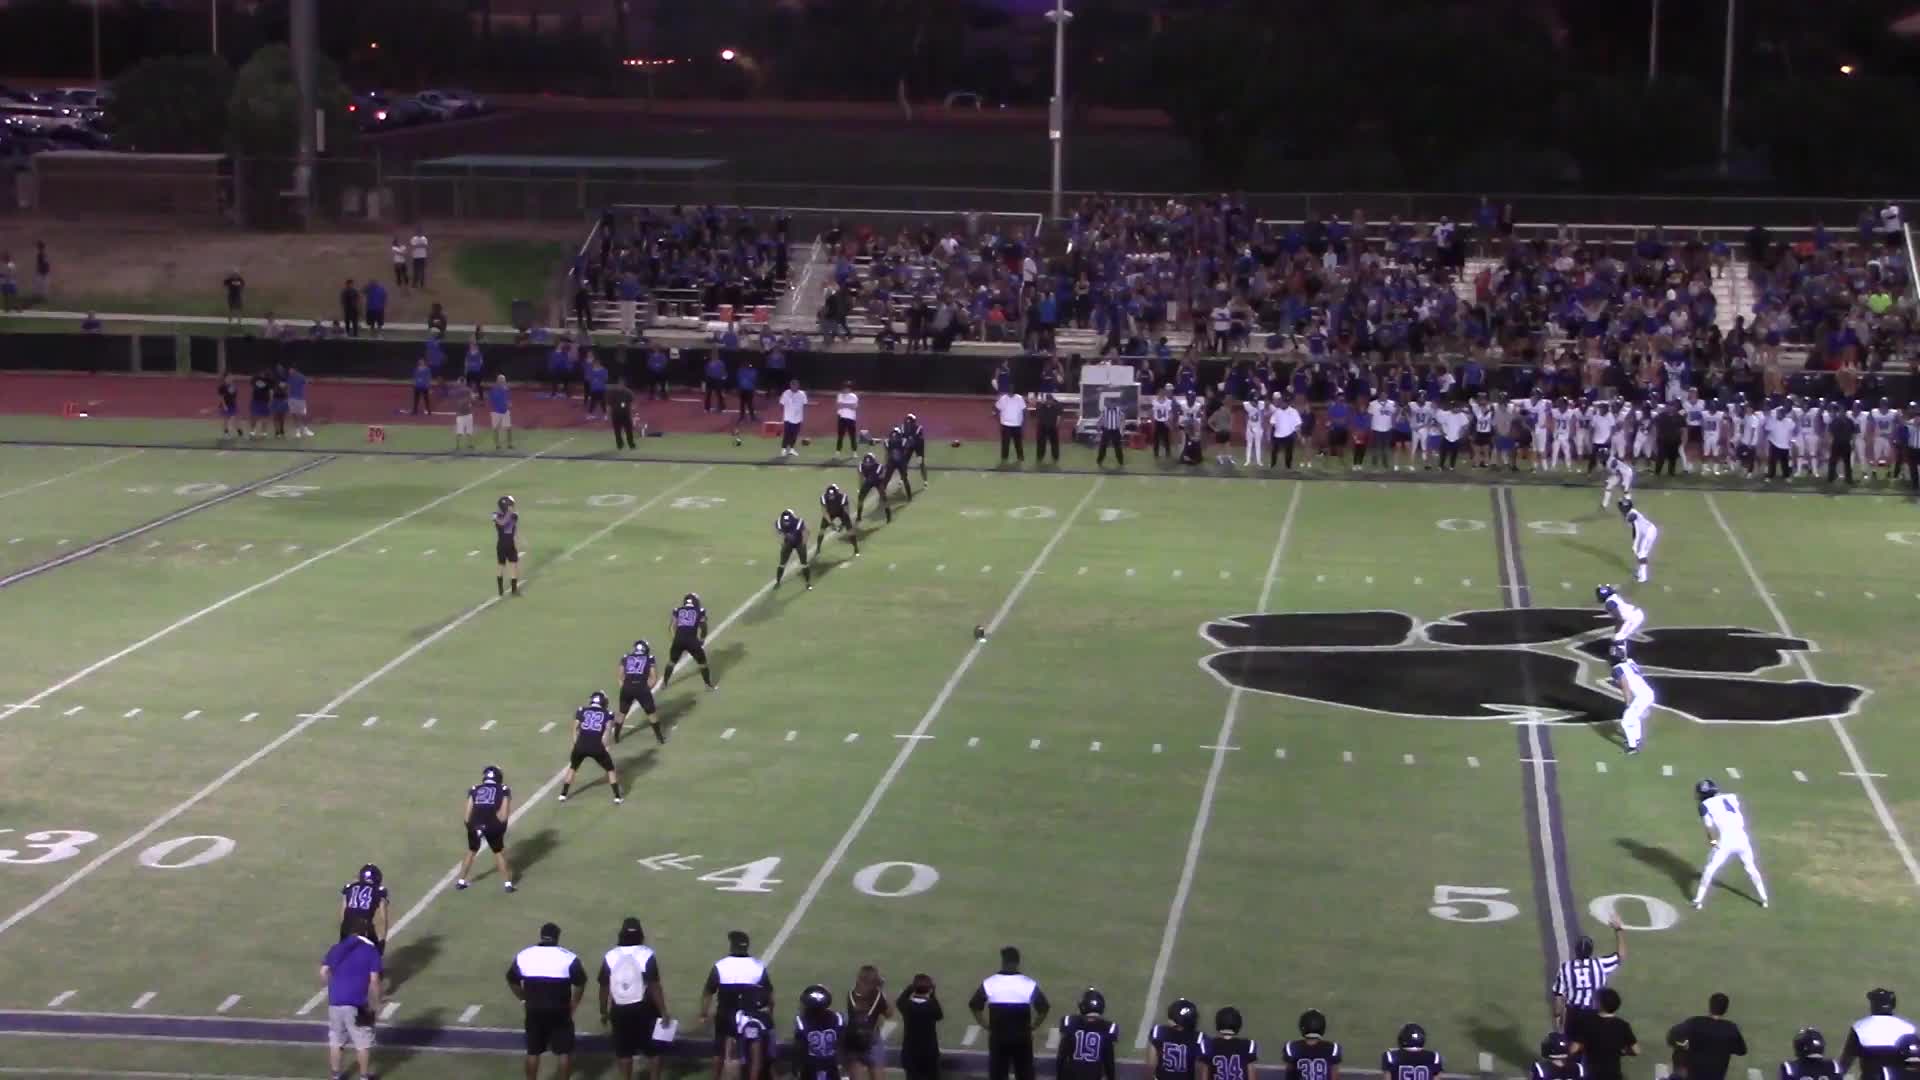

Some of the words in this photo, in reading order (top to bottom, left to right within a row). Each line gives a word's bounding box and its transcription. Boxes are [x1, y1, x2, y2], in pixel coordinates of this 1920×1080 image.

[474, 786, 497, 805] 21
[348, 885, 374, 910] 14
[1574, 967, 1593, 989] H
[1073, 1030, 1101, 1062] 19
[1163, 1042, 1188, 1073] 51
[1212, 1054, 1244, 1080] 34
